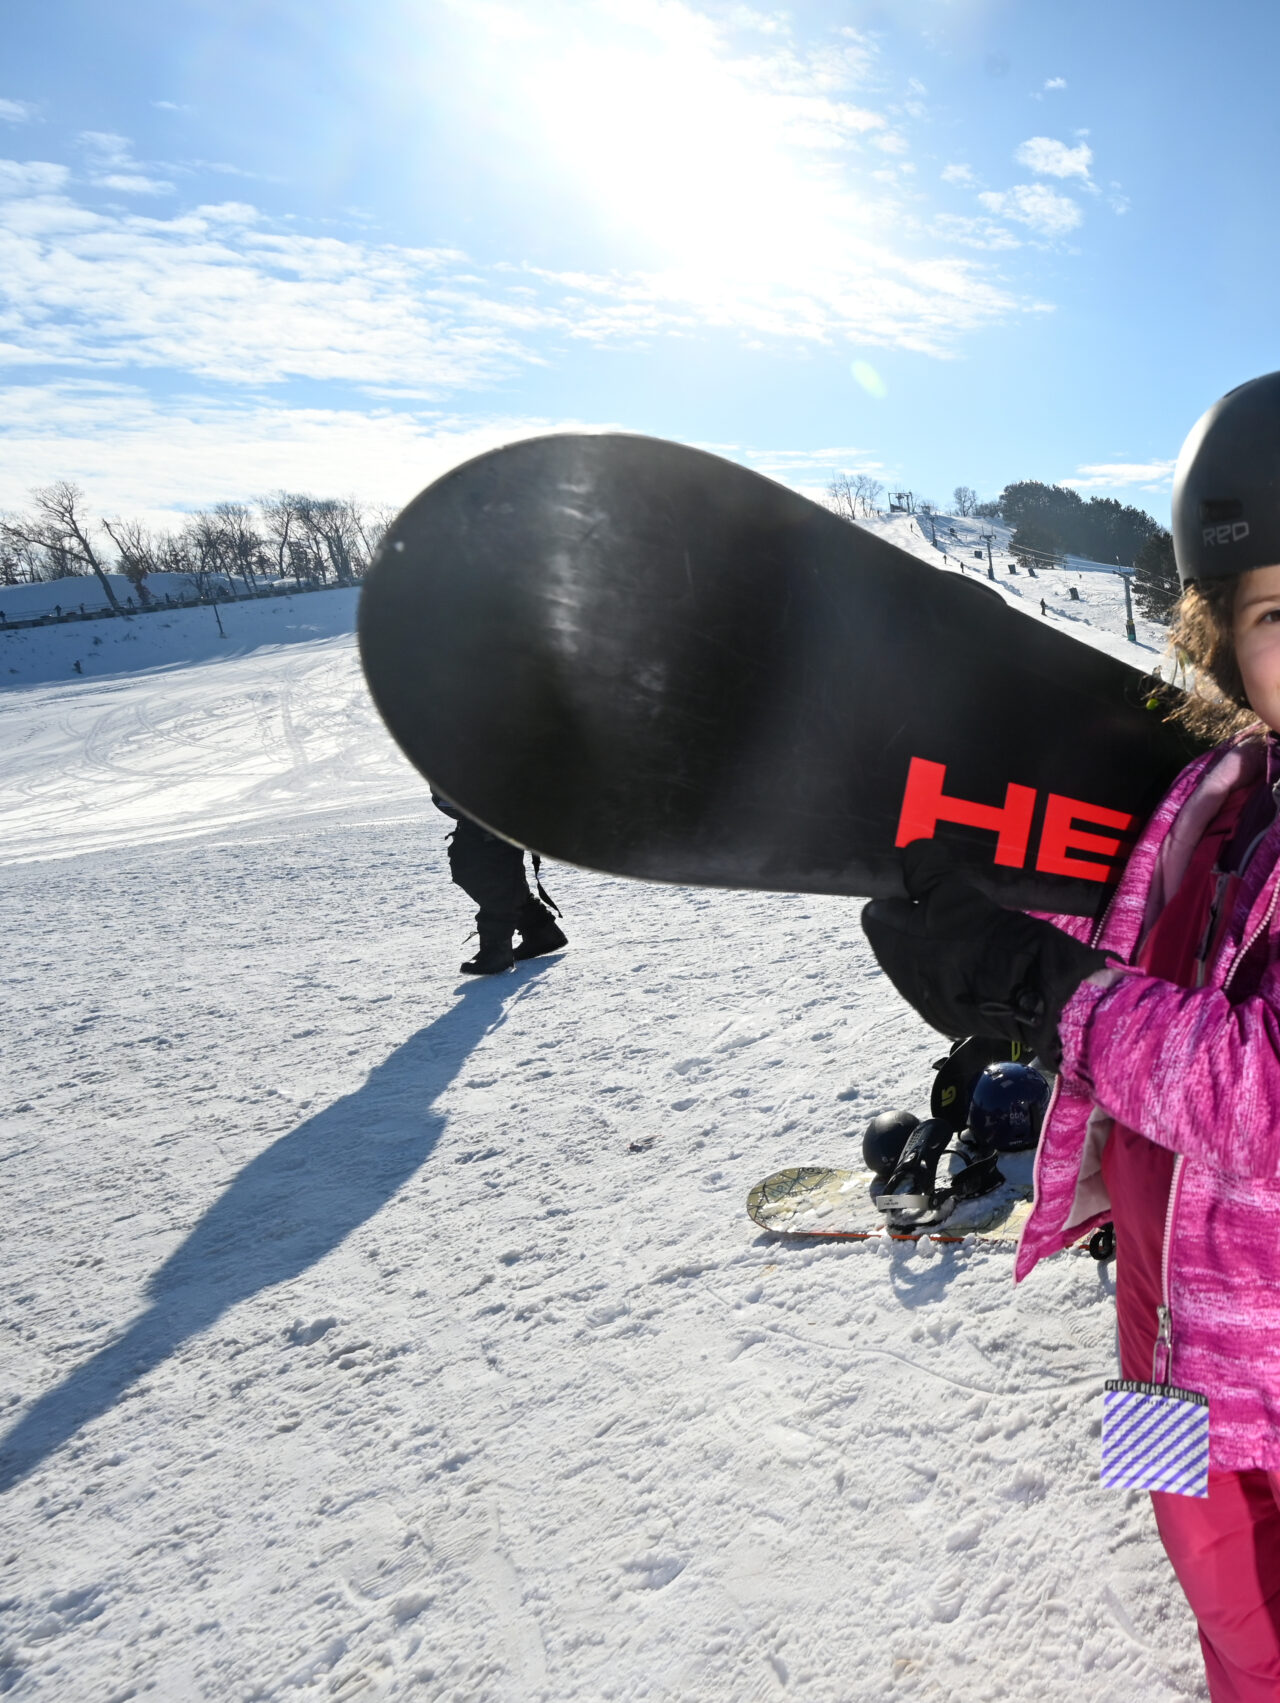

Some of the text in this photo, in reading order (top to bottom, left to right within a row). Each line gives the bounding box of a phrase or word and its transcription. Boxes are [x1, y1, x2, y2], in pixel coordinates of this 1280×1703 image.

[1202, 521, 1249, 547] RED
[1107, 1380, 1206, 1406] PLEASE READ CAREFULLY
